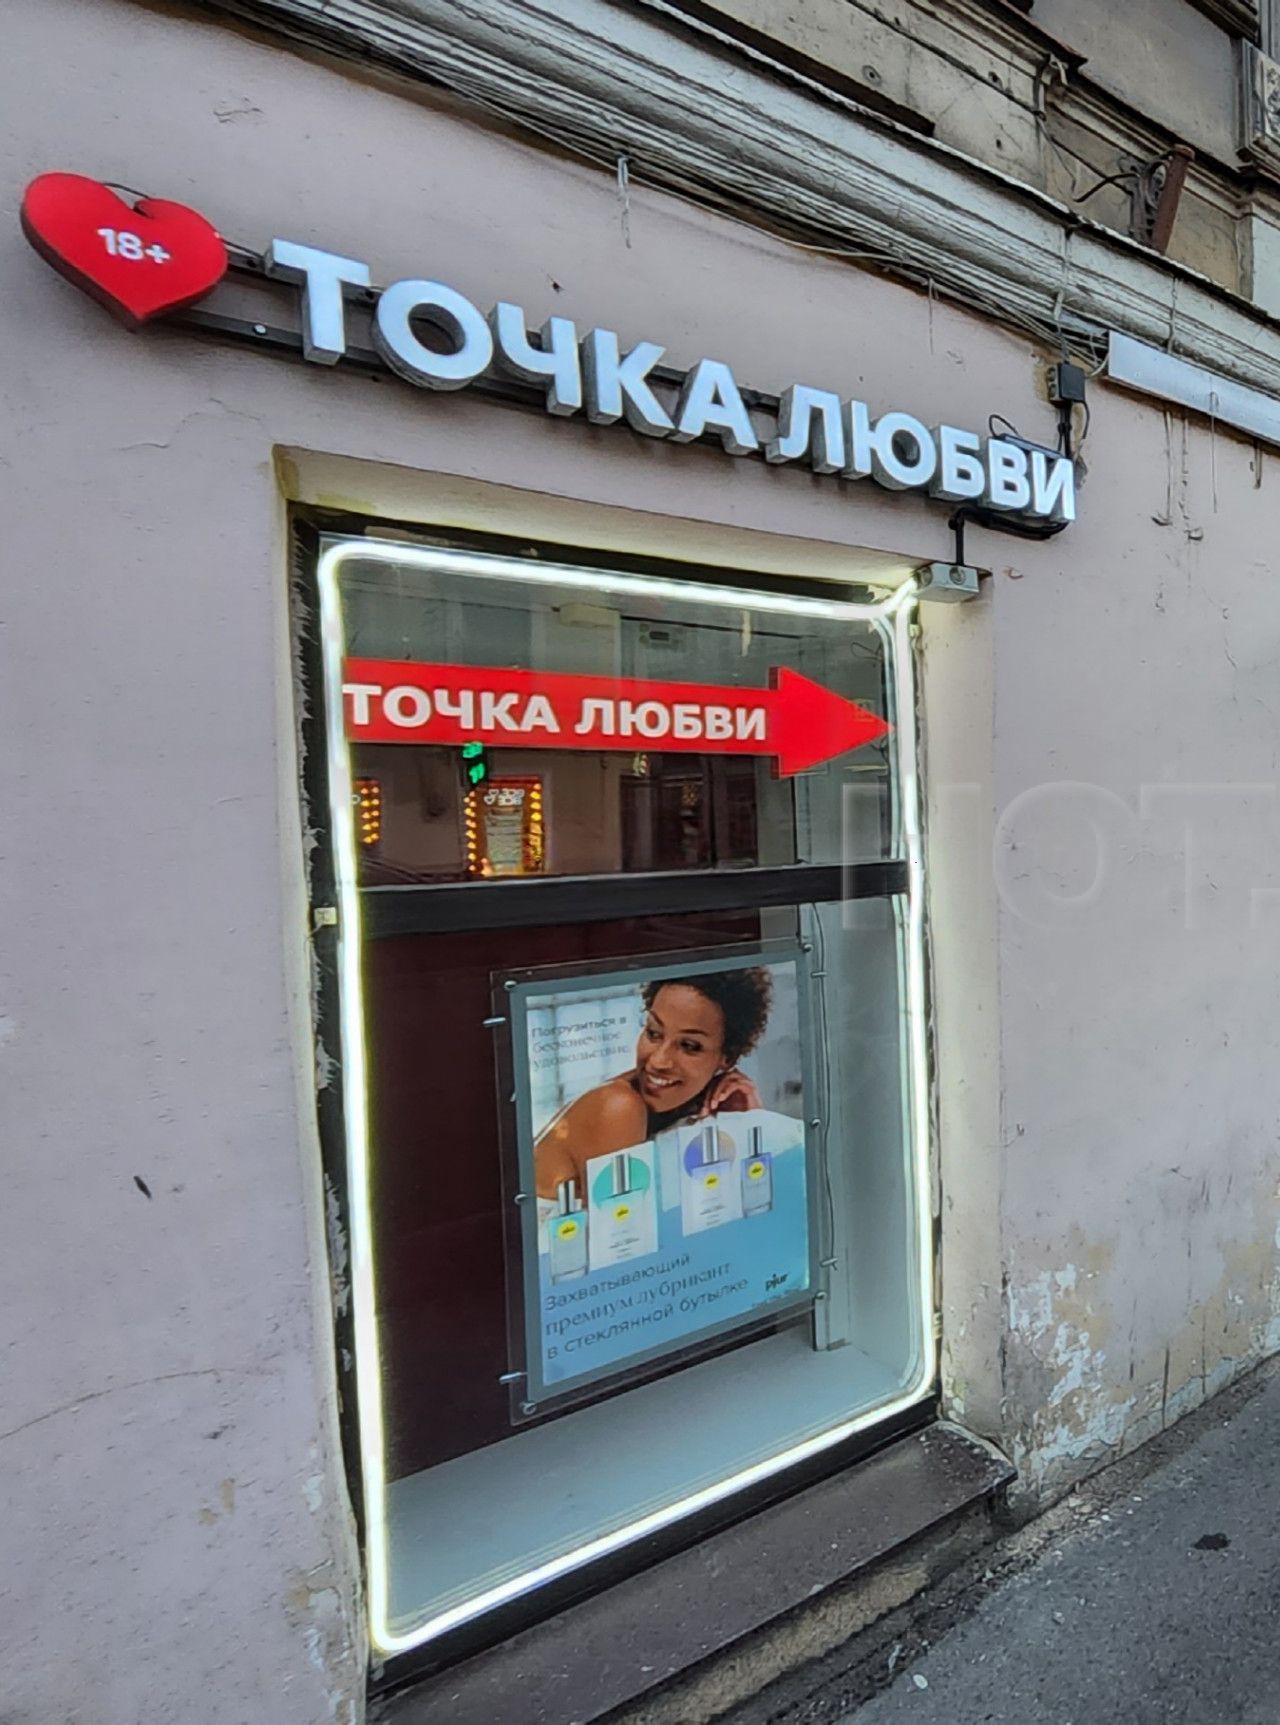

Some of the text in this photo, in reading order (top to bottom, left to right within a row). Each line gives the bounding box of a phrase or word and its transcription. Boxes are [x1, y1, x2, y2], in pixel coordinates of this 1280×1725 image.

[97, 226, 171, 266] 18+
[264, 237, 1077, 524] ТОЧКА ЛЮБВИ
[343, 683, 767, 742] ТОЧКА ЛЮБВИ
[544, 1252, 690, 1313] Захватывающий
[764, 1272, 789, 1292] pjur
[547, 1347, 559, 1360] в
[564, 1308, 674, 1354] стеклянной
[679, 1276, 749, 1315] бутылке
